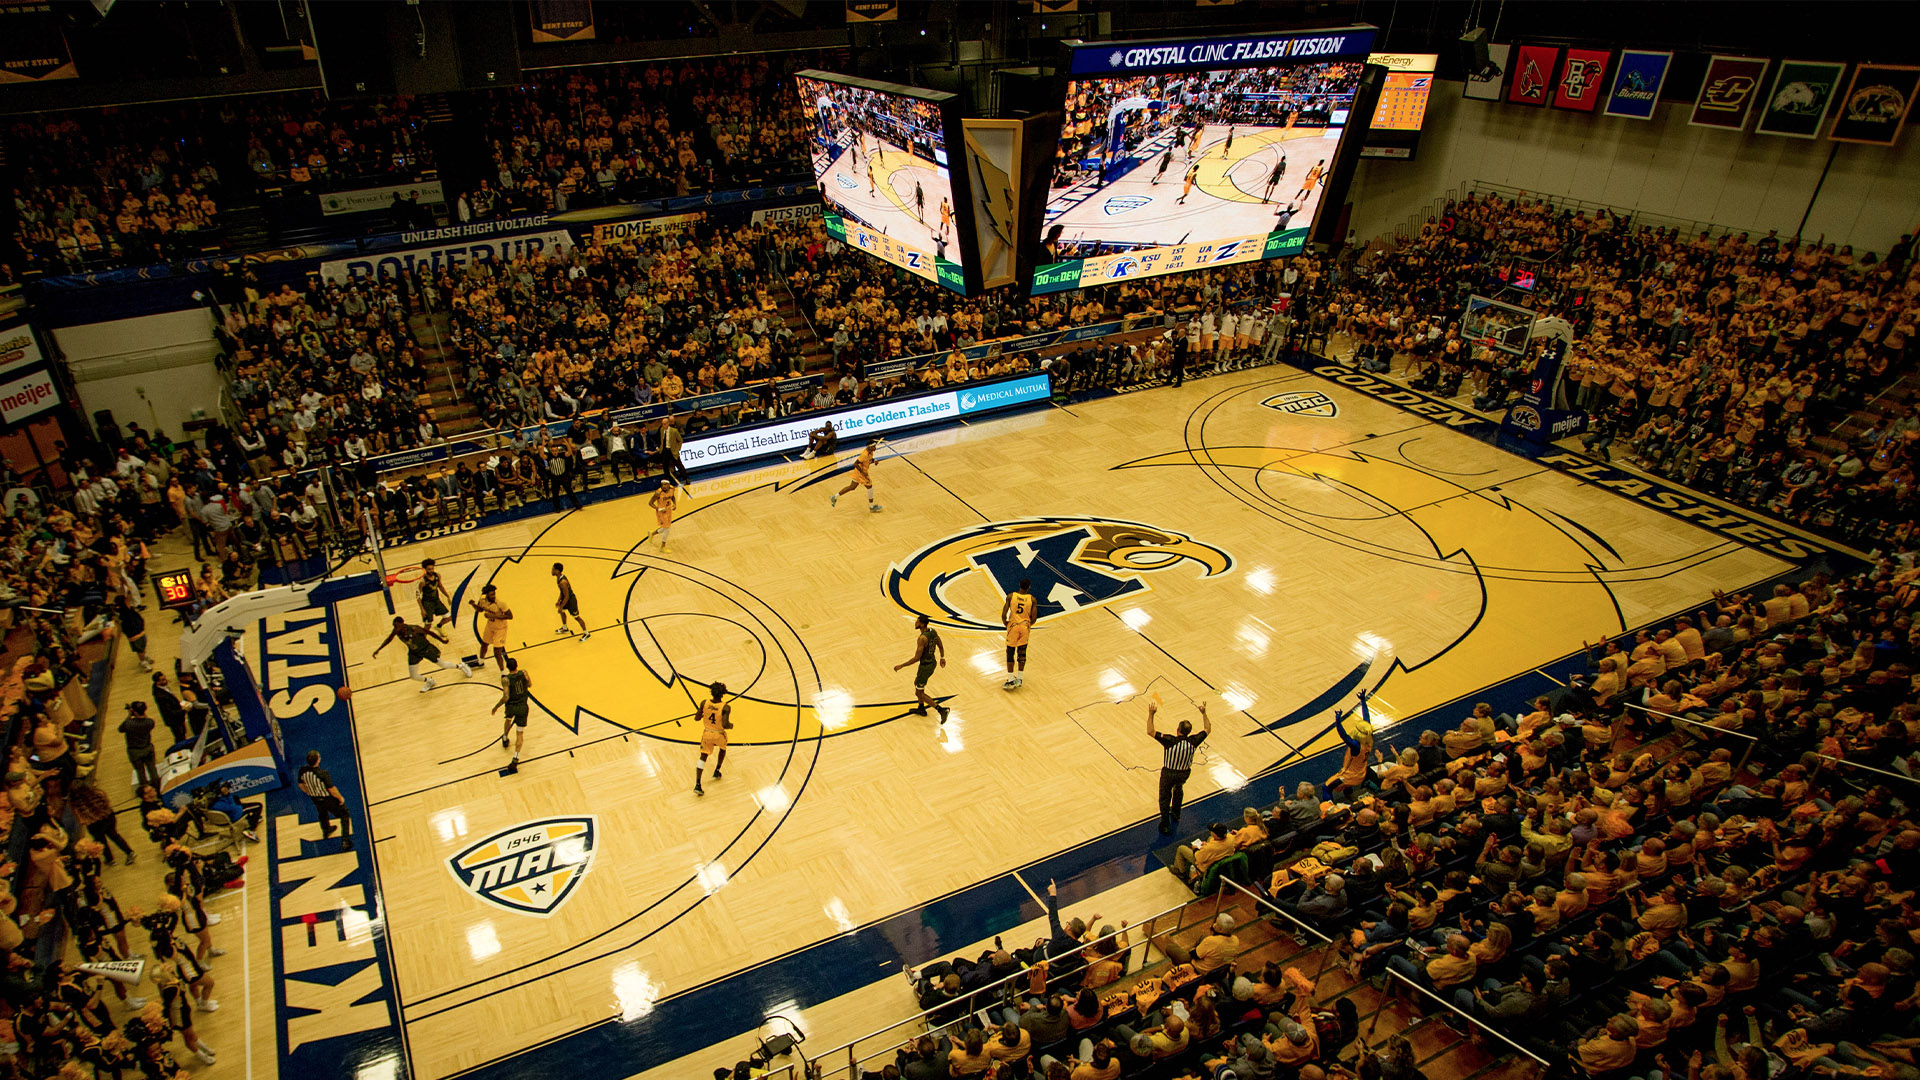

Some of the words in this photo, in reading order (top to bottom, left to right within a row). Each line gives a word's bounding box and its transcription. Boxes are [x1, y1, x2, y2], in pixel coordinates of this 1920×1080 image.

[541, 22, 561, 30] KENT
[562, 20, 584, 29] STATE
[1124, 46, 1187, 67] CRYSTAL
[1188, 43, 1230, 64] CLINIC
[764, 208, 793, 221] HITS
[795, 205, 823, 218] BOO
[401, 226, 461, 244] UNLEASH
[463, 221, 494, 237] HIGH
[495, 214, 549, 232] VOLTAGE
[602, 220, 651, 240] HOME
[653, 224, 662, 233] IS
[500, 238, 545, 265] UP
[1199, 245, 1212, 253] UA
[1208, 240, 1246, 263] Z
[1267, 240, 1278, 250] DO
[1278, 240, 1287, 249] THE
[1287, 236, 1305, 247] DEW
[906, 251, 922, 269] Z
[1141, 254, 1161, 263] KSU
[1144, 263, 1152, 271] 3
[1196, 255, 1208, 263] 11
[937, 265, 945, 277] DO
[951, 272, 964, 286] DEW
[1035, 274, 1049, 286] DO
[1048, 273, 1060, 283] THE
[1060, 269, 1081, 282] DEW
[1112, 261, 1131, 277] K
[1514, 269, 1534, 288] 30
[1, 381, 52, 412] meijer
[977, 389, 1014, 403] MEDICAL
[1015, 382, 1047, 396] MUTUAL
[1313, 365, 1485, 427] GOLDEN
[1276, 396, 1326, 412] MAC
[681, 448, 705, 462] The
[707, 437, 749, 456] Official
[751, 431, 789, 449] Health
[832, 420, 844, 432] of
[845, 418, 863, 430] the
[866, 411, 907, 425] Golden
[908, 402, 951, 417] Flashes
[1552, 414, 1582, 434] meijer
[1536, 452, 1829, 559] FLASHES
[415, 519, 478, 541] OHIO
[966, 526, 1148, 621] K
[165, 585, 188, 600] 30
[1016, 603, 1025, 615] 5
[265, 605, 336, 719] STAT
[708, 712, 716, 725] 4
[247, 774, 275, 789] CENTER
[507, 832, 542, 850] 1946
[276, 811, 393, 1056] KENT
